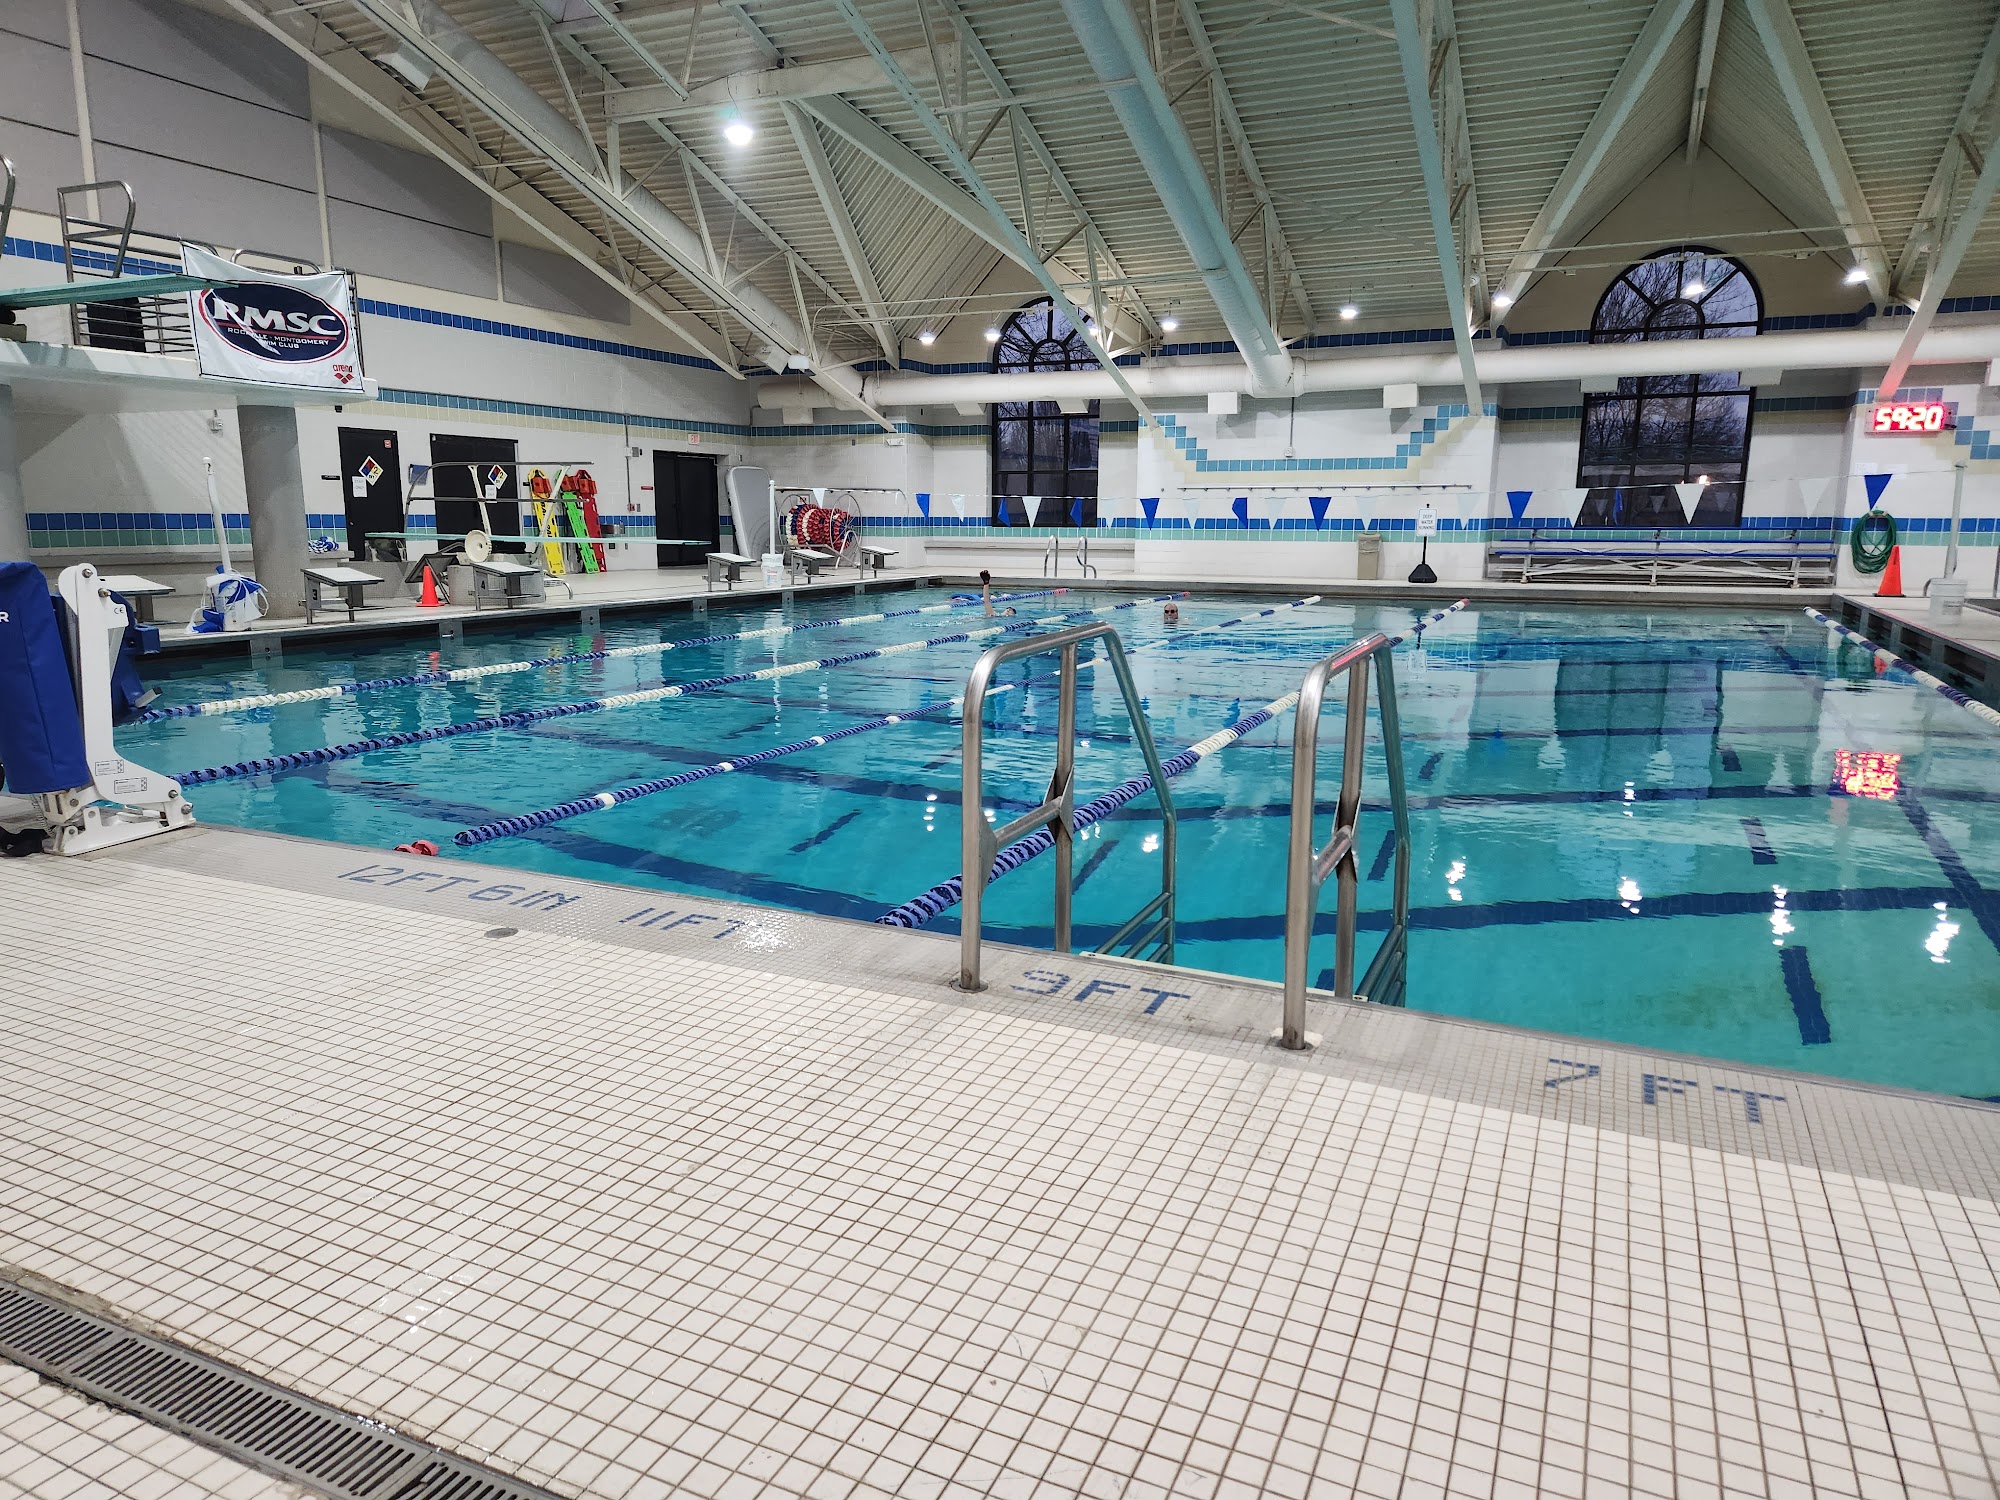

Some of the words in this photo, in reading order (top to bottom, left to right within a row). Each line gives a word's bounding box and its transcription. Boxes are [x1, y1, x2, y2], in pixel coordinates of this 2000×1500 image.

[212, 298, 342, 336] RMSC
[274, 335, 329, 346] MONTGOMERY
[333, 364, 353, 373] arena
[1875, 405, 1943, 431] 59:20
[374, 466, 379, 475] 2
[480, 580, 486, 590] 4
[312, 588, 318, 601] 3
